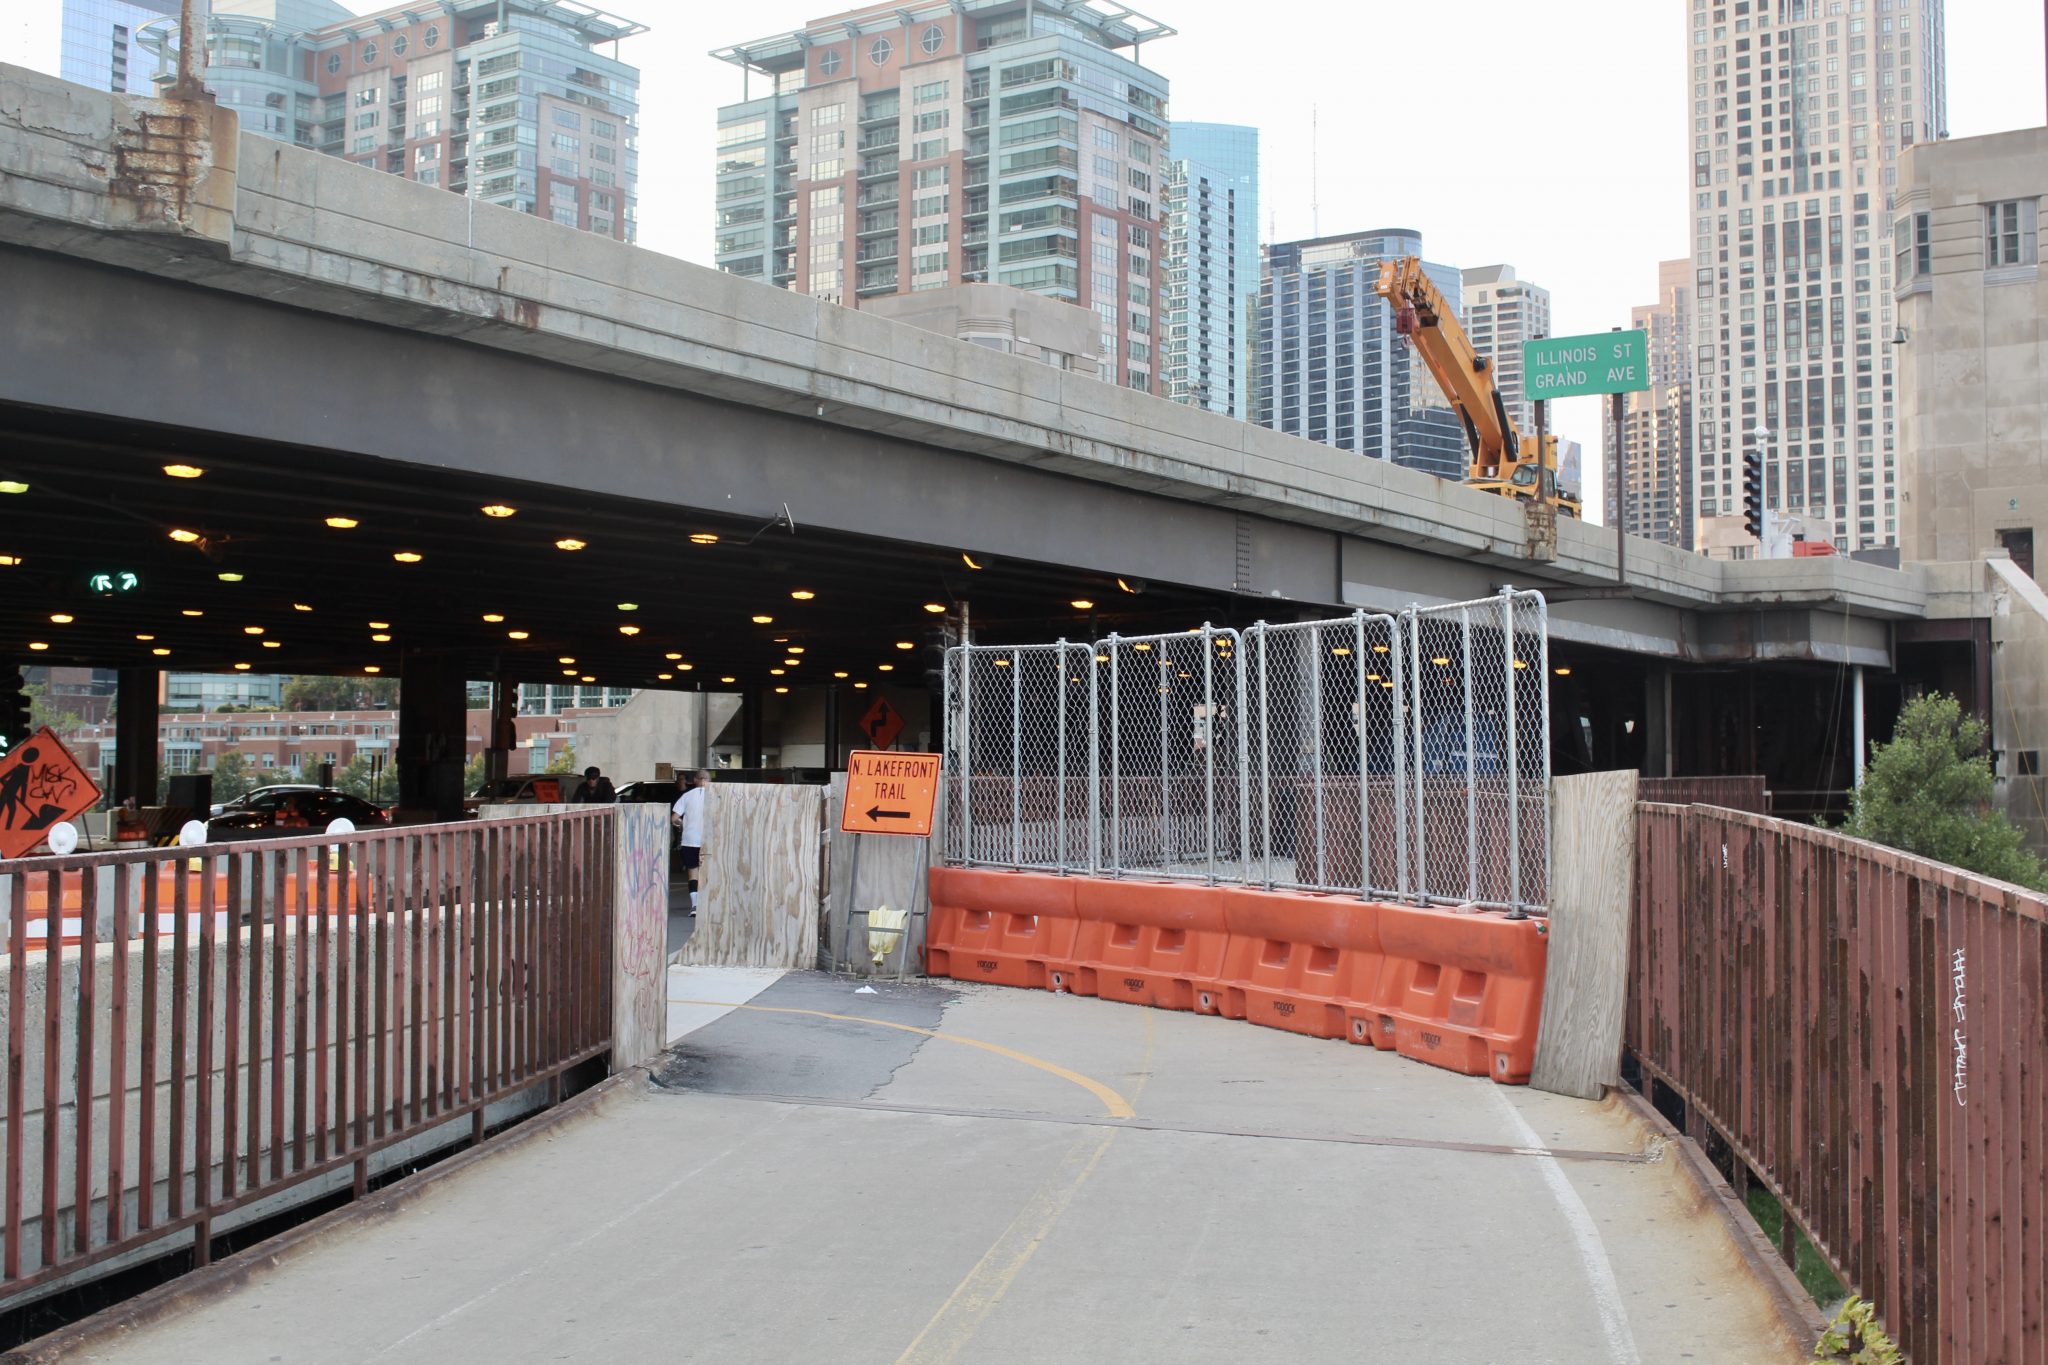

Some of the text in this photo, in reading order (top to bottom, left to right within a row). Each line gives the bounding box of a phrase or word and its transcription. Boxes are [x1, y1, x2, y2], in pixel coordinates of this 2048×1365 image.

[1536, 344, 1632, 366] ILLINOIS ST
[1535, 366, 1635, 389] GRAND AVE
[852, 759, 935, 778] N. LAKEFRONT
[874, 782, 906, 800] TRAIL
